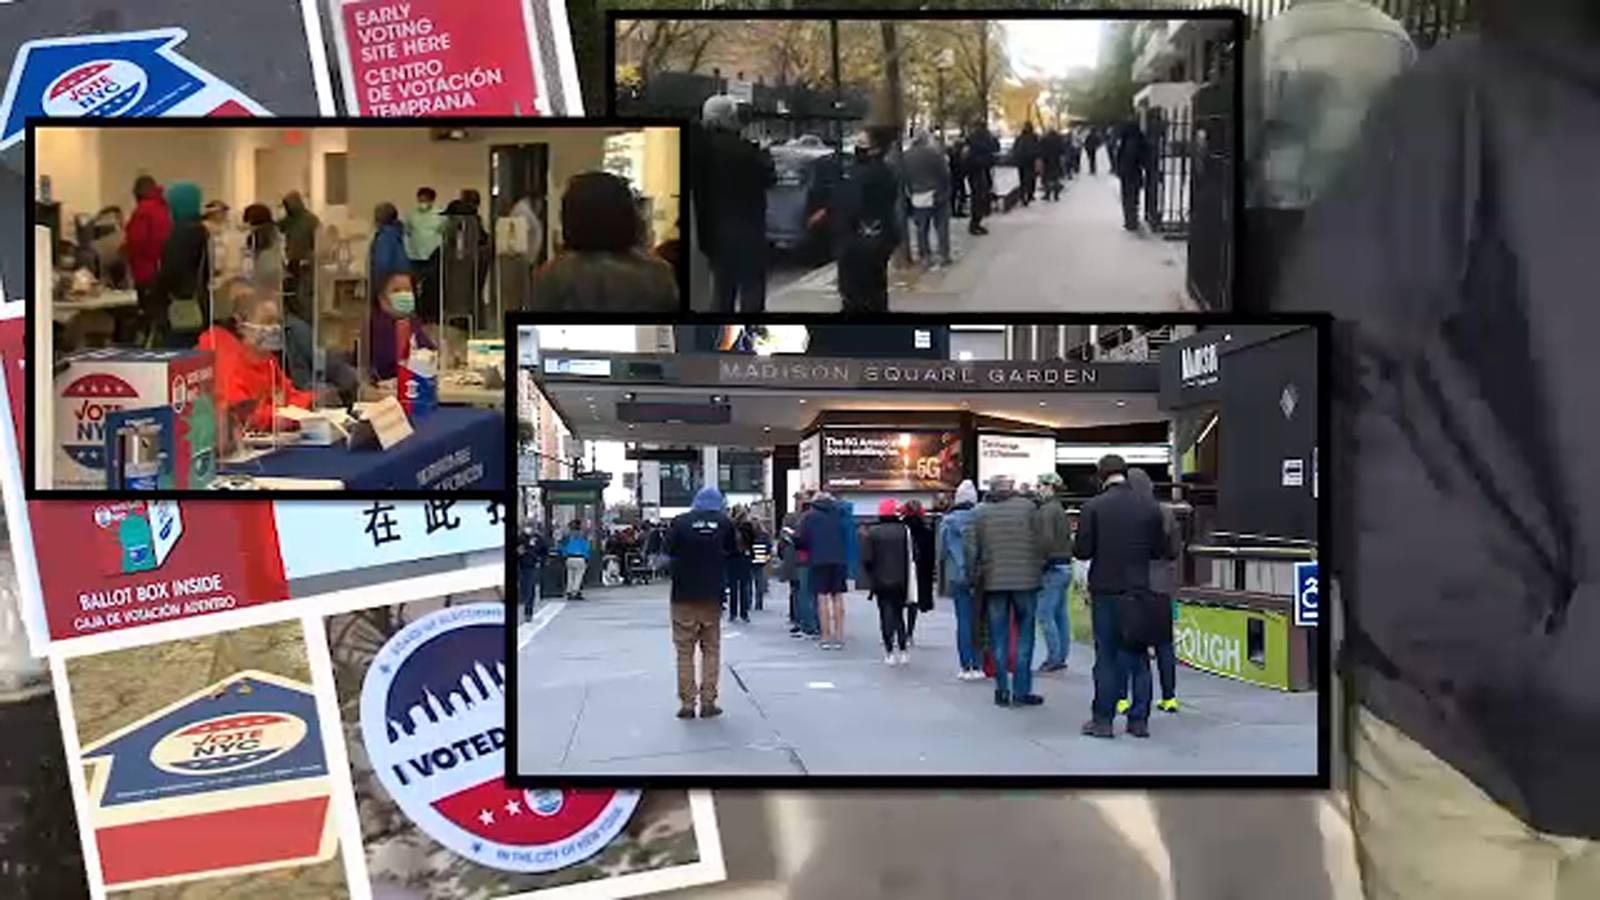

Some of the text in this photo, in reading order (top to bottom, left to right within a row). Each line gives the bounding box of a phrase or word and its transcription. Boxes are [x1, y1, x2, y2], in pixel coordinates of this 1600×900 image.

[355, 4, 411, 26] EARLY
[357, 18, 433, 43] VOTING
[361, 33, 451, 63] SITE HERE
[364, 59, 443, 86] CENTRO
[367, 66, 502, 103] DE VOTACIÓN
[369, 92, 476, 117] TEMPRANA
[718, 362, 1096, 384] MADISON SQUARE GARDEN
[79, 575, 223, 611] BALLOT BOX INSIDE
[107, 612, 122, 625] DE
[191, 729, 264, 746] VOTE
[193, 738, 261, 758] NYC
[392, 727, 505, 786] I VOTED
